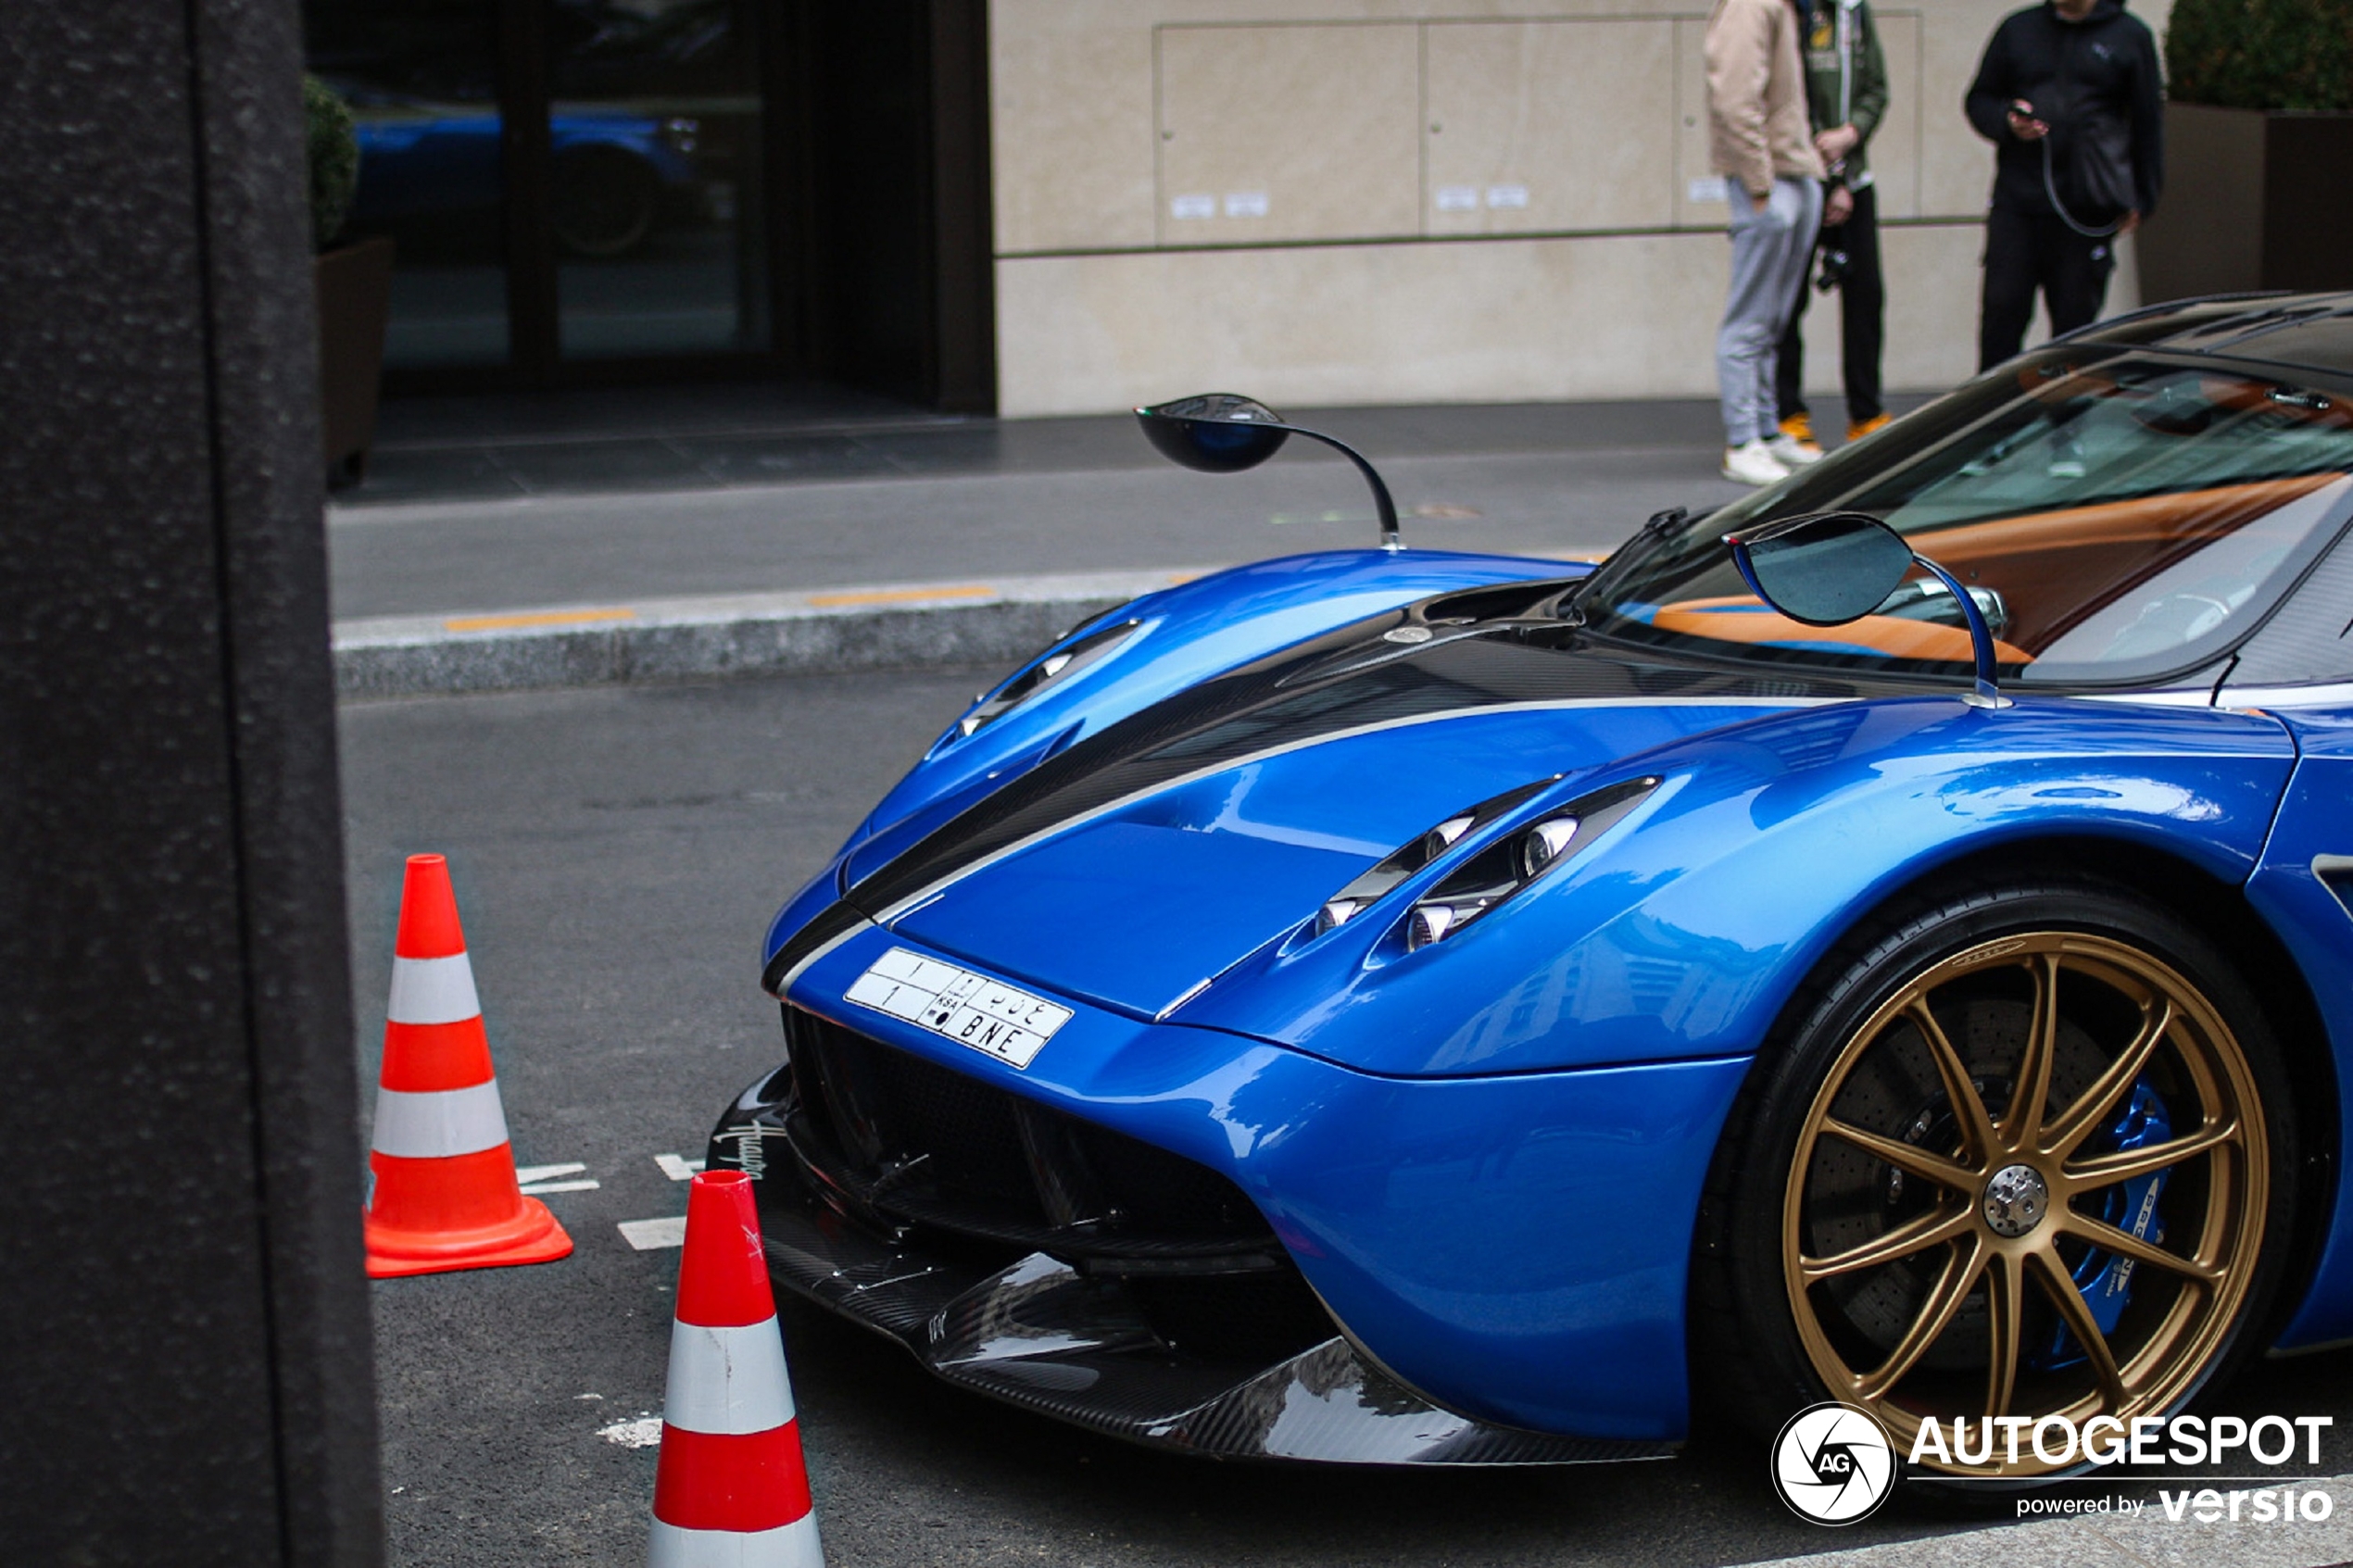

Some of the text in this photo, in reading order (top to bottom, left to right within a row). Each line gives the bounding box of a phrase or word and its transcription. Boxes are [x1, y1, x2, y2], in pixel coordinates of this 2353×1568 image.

[882, 985, 900, 1006] 1
[937, 996, 959, 1010] KSA
[961, 1015, 1022, 1054] BNE
